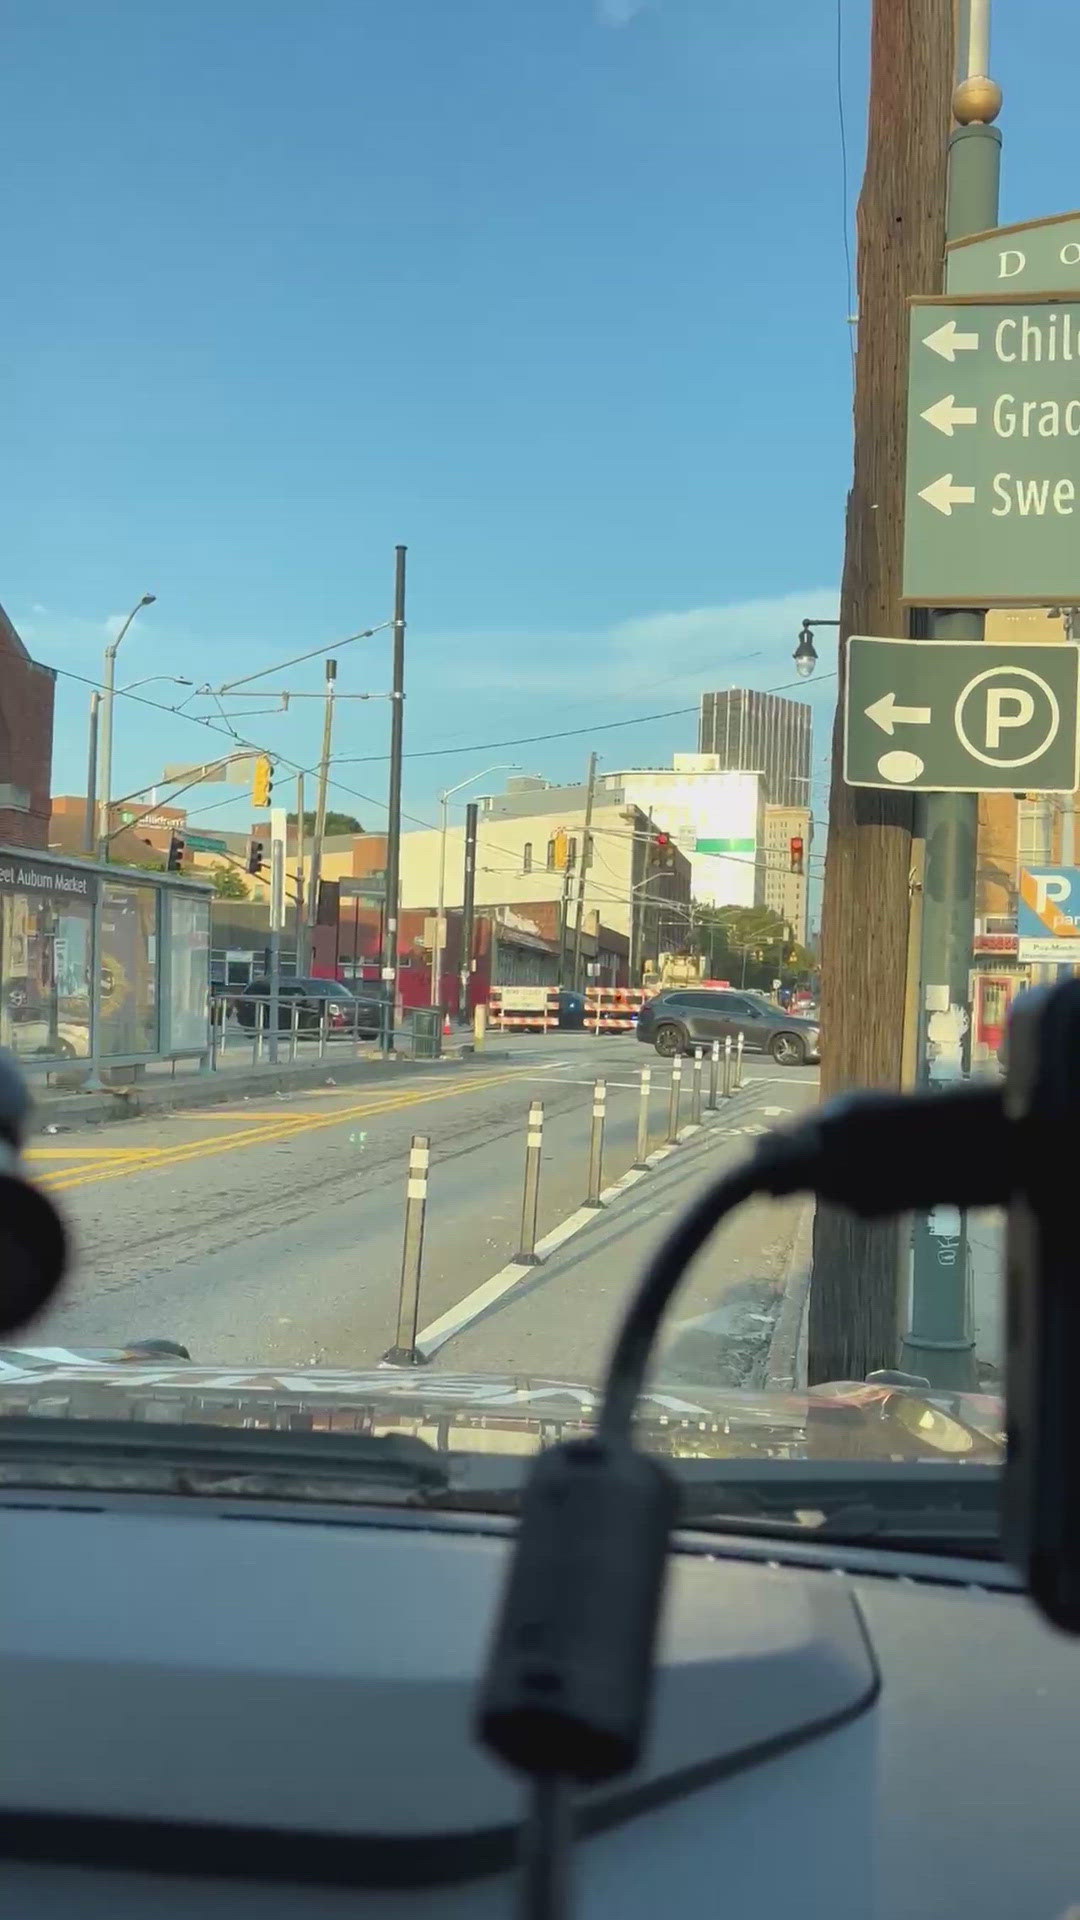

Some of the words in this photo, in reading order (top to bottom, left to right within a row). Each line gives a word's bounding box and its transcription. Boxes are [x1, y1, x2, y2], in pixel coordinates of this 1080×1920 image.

[994, 314, 1080, 362] Chil
[991, 473, 1075, 516] Swe
[985, 688, 1034, 748] P
[17, 868, 53, 889] Auburn
[54, 874, 87, 894] Market
[1031, 875, 1072, 913] P
